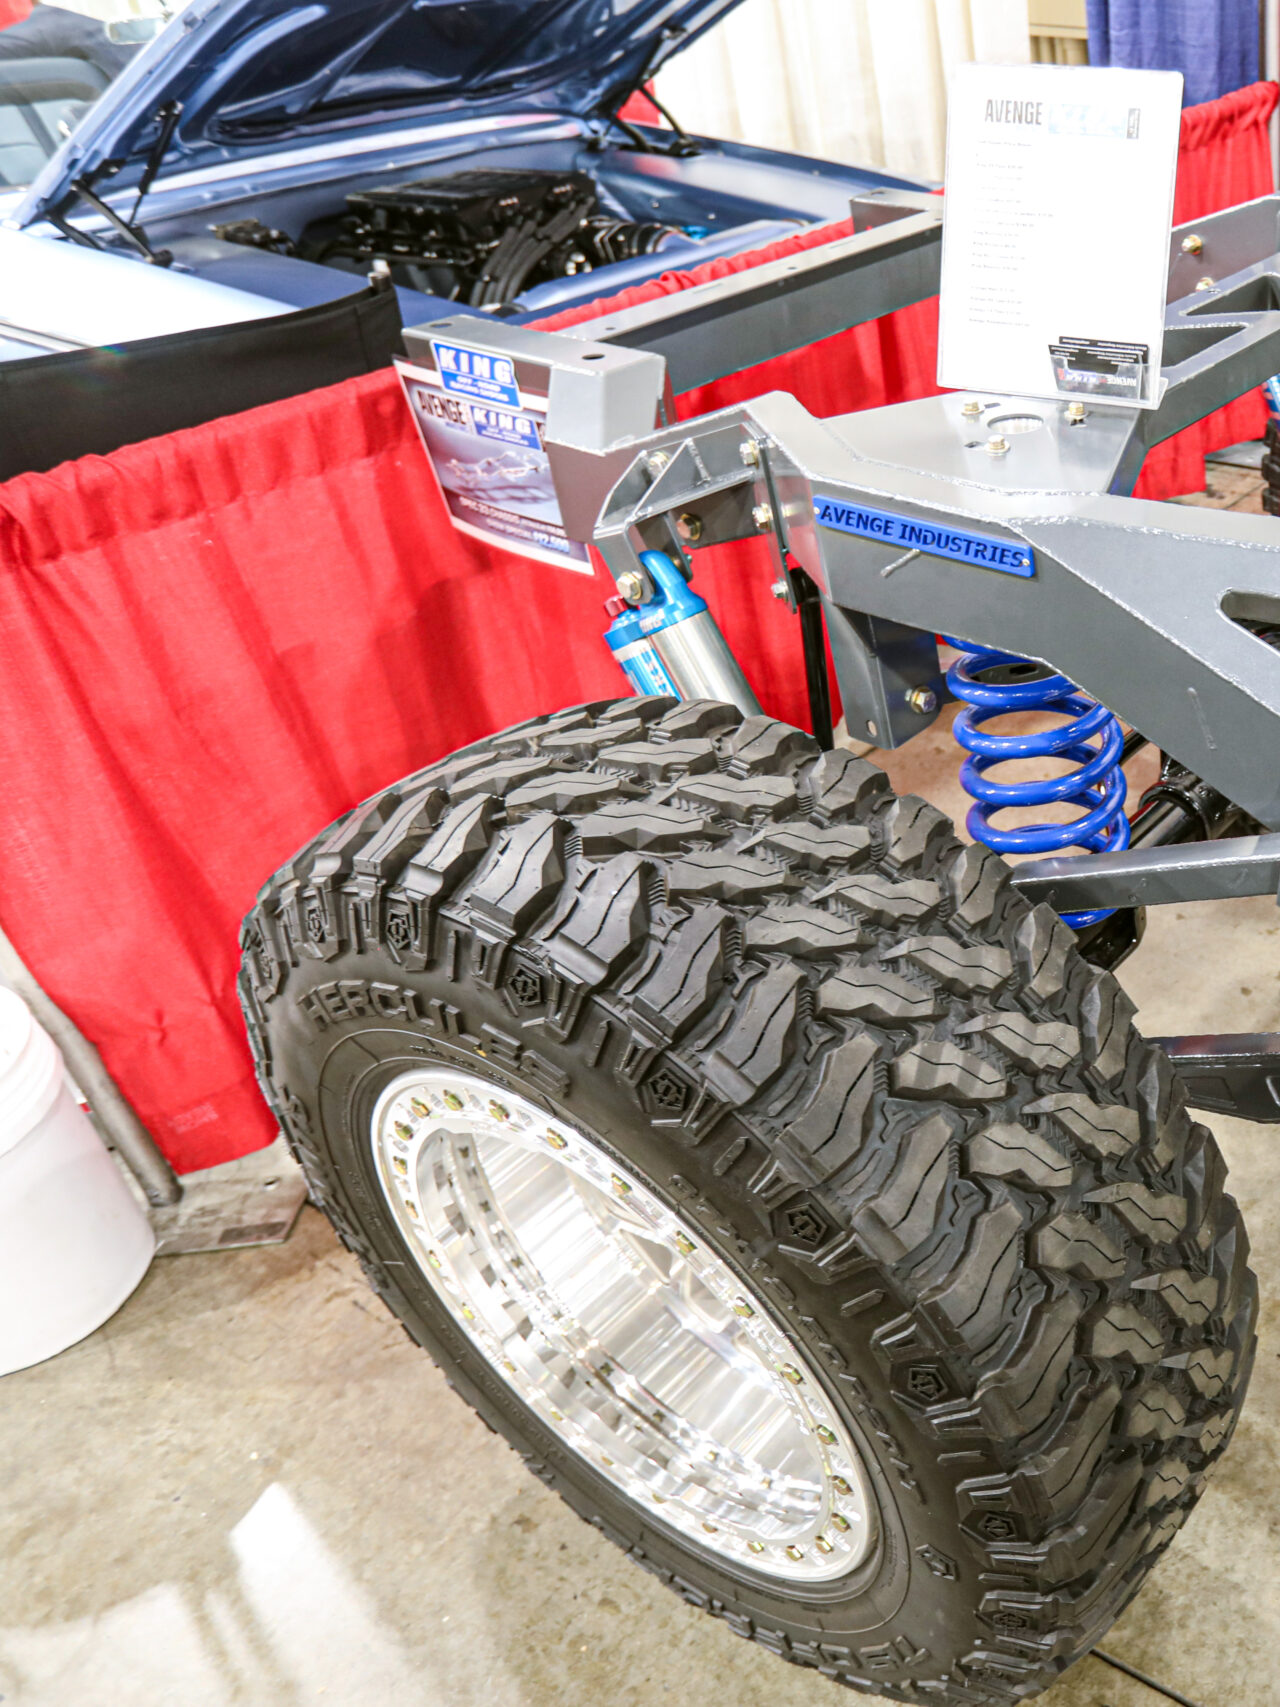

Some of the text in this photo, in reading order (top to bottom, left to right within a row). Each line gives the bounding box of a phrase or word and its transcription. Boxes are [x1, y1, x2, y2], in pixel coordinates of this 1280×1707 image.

[984, 98, 1044, 126] AVENGE
[438, 346, 513, 385] KING
[416, 389, 467, 425] AVENGE
[472, 407, 532, 435] KING
[820, 504, 1026, 568] AVENGE INDUSTRIES
[297, 979, 572, 1098] HERCULES
